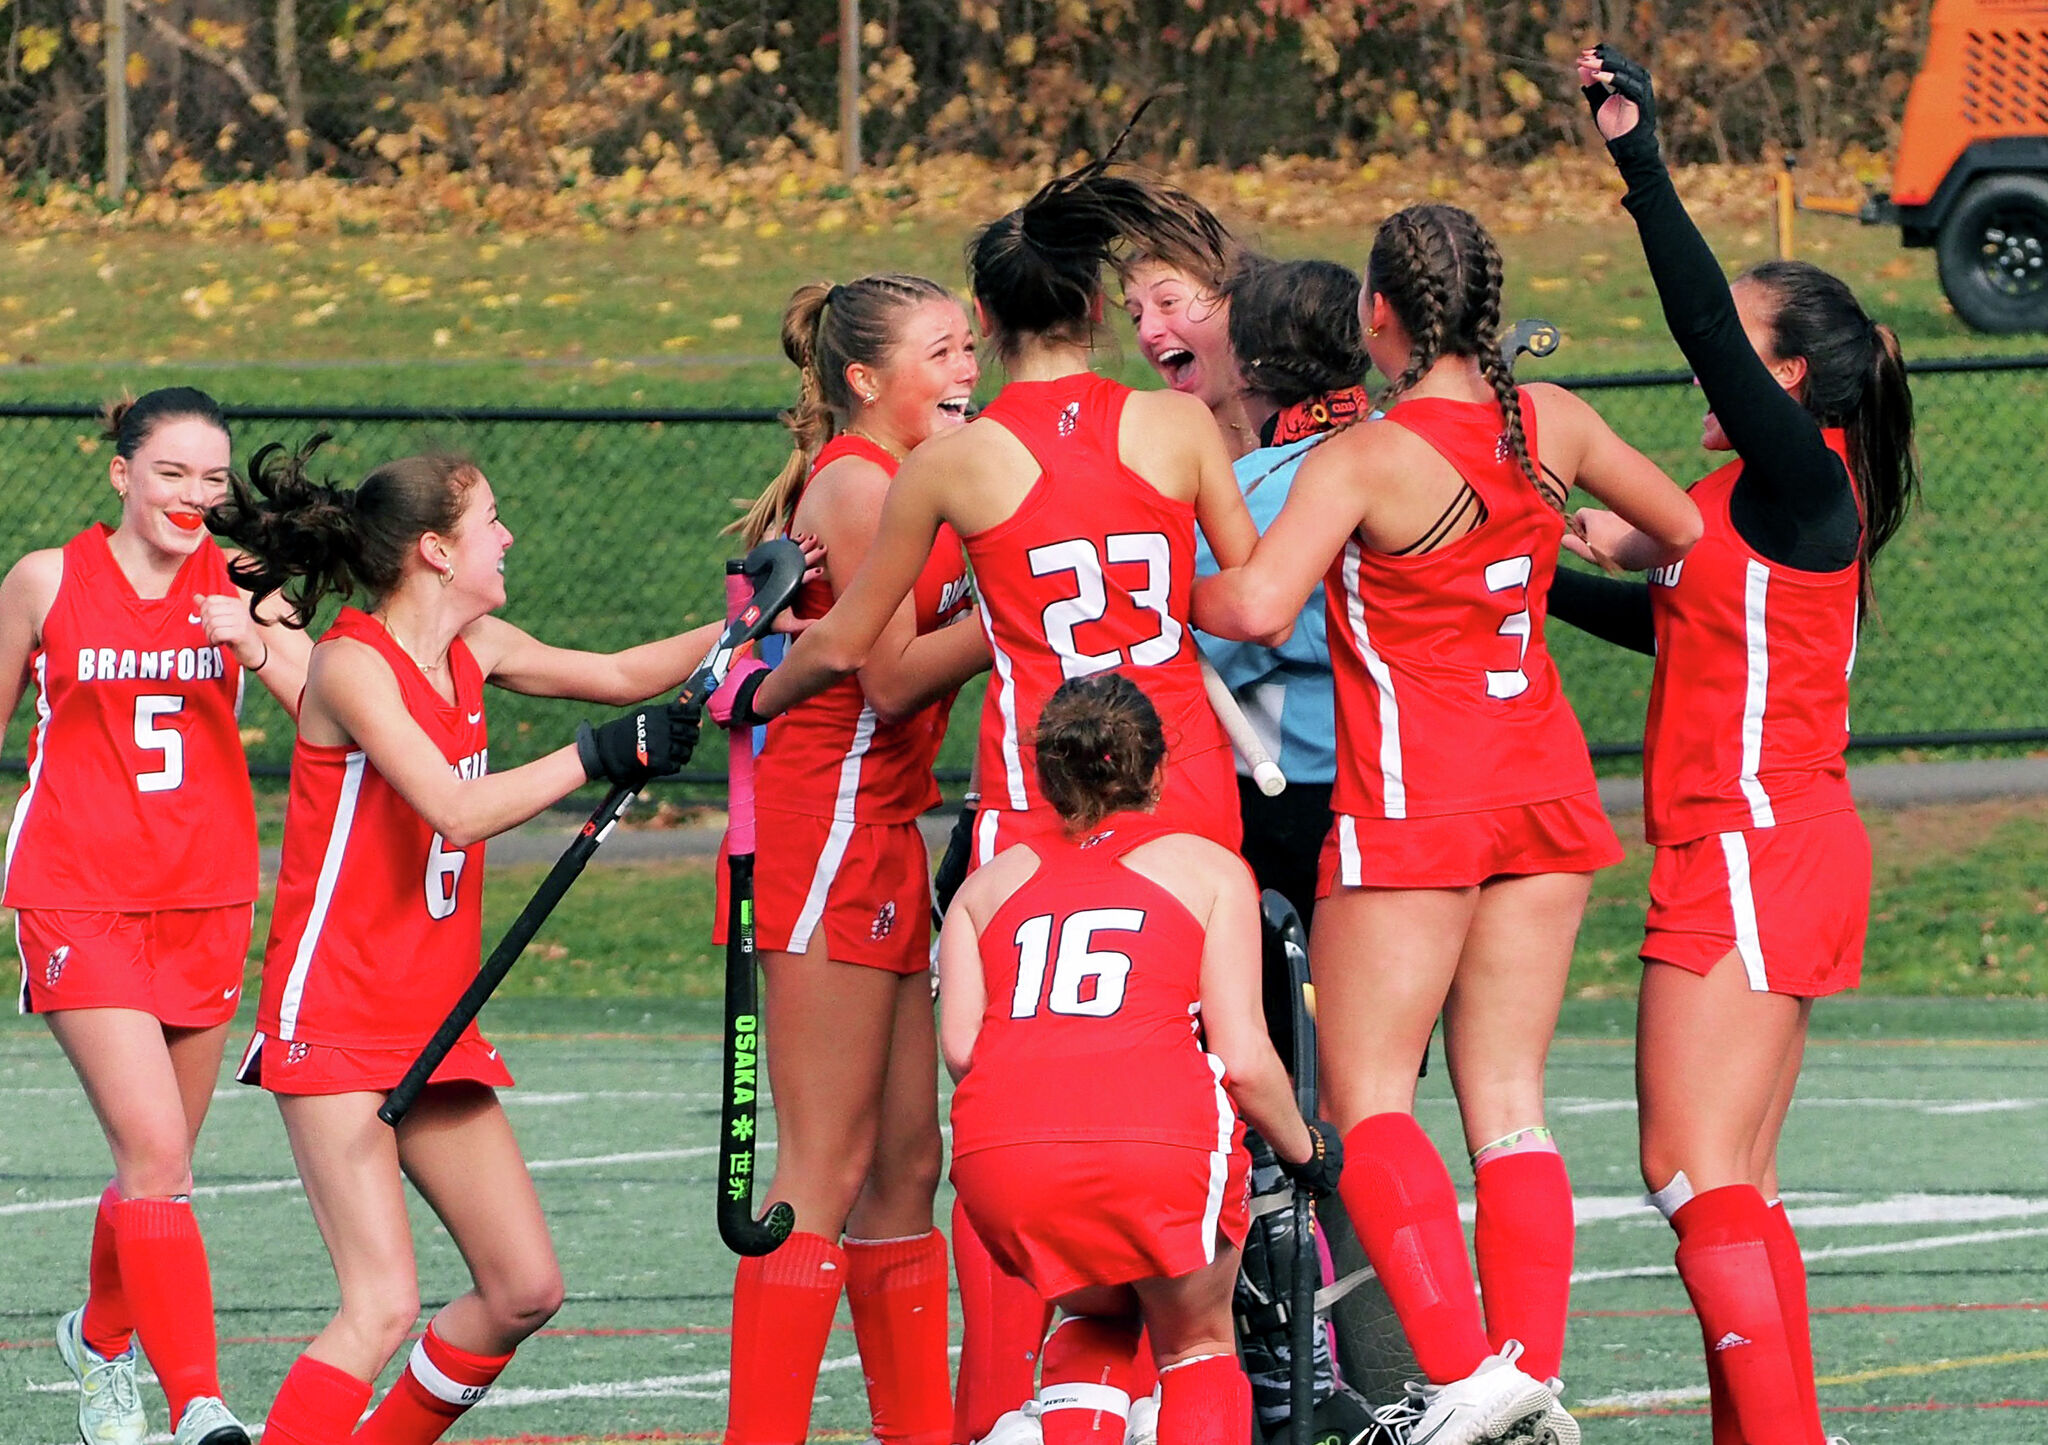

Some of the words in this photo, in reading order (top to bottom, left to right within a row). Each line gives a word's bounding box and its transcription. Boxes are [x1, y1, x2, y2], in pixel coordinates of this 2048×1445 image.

[1027, 532, 1183, 681] 23
[1485, 555, 1532, 699] 3
[134, 694, 185, 792] 5
[425, 831, 466, 920] 6
[1010, 907, 1147, 1020] 16
[733, 1015, 757, 1105] OSAKA
